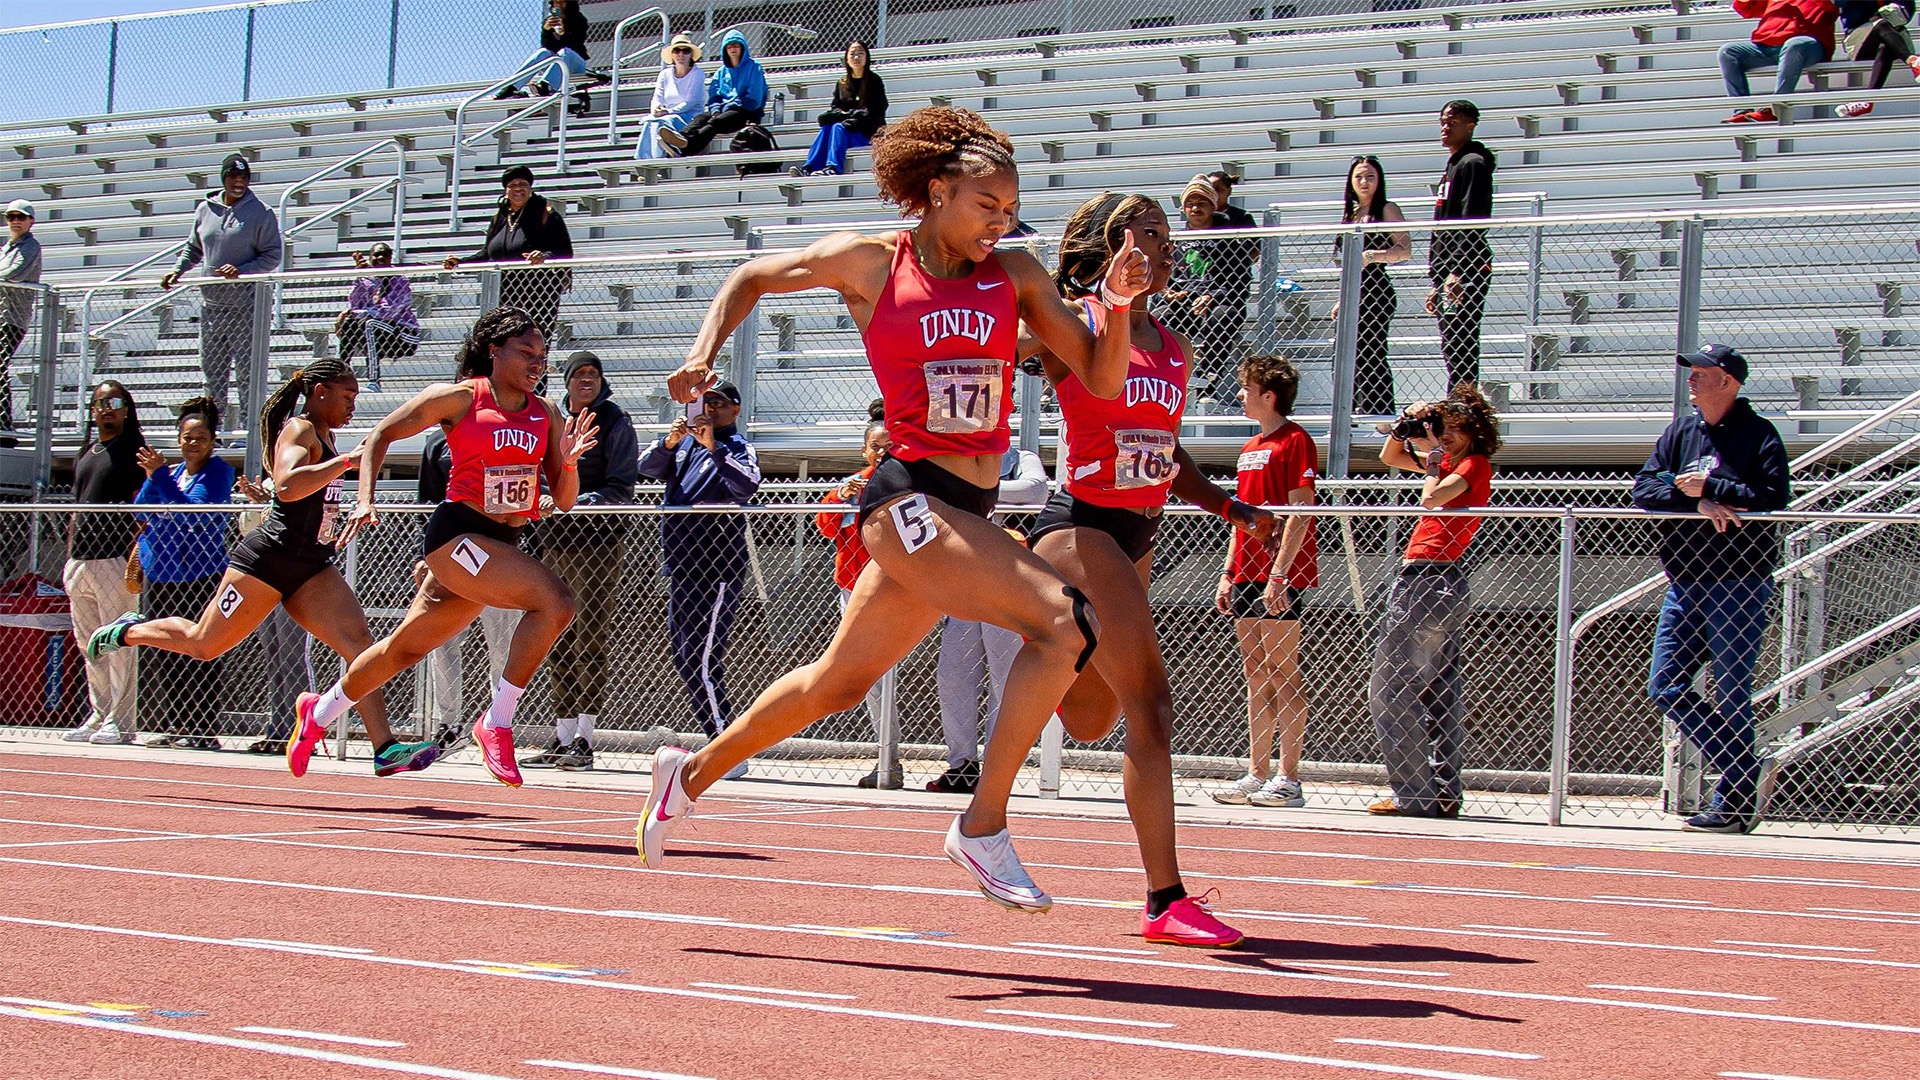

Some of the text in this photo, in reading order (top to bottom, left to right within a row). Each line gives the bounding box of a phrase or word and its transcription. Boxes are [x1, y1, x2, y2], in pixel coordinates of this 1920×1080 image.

[919, 308, 996, 348] UNLV
[943, 383, 991, 418] 171
[1124, 376, 1183, 416] UNLV
[492, 428, 539, 455] UNLV
[494, 480, 530, 505] 156
[897, 499, 927, 547] 5
[455, 542, 481, 570] 7
[221, 589, 238, 613] 8
